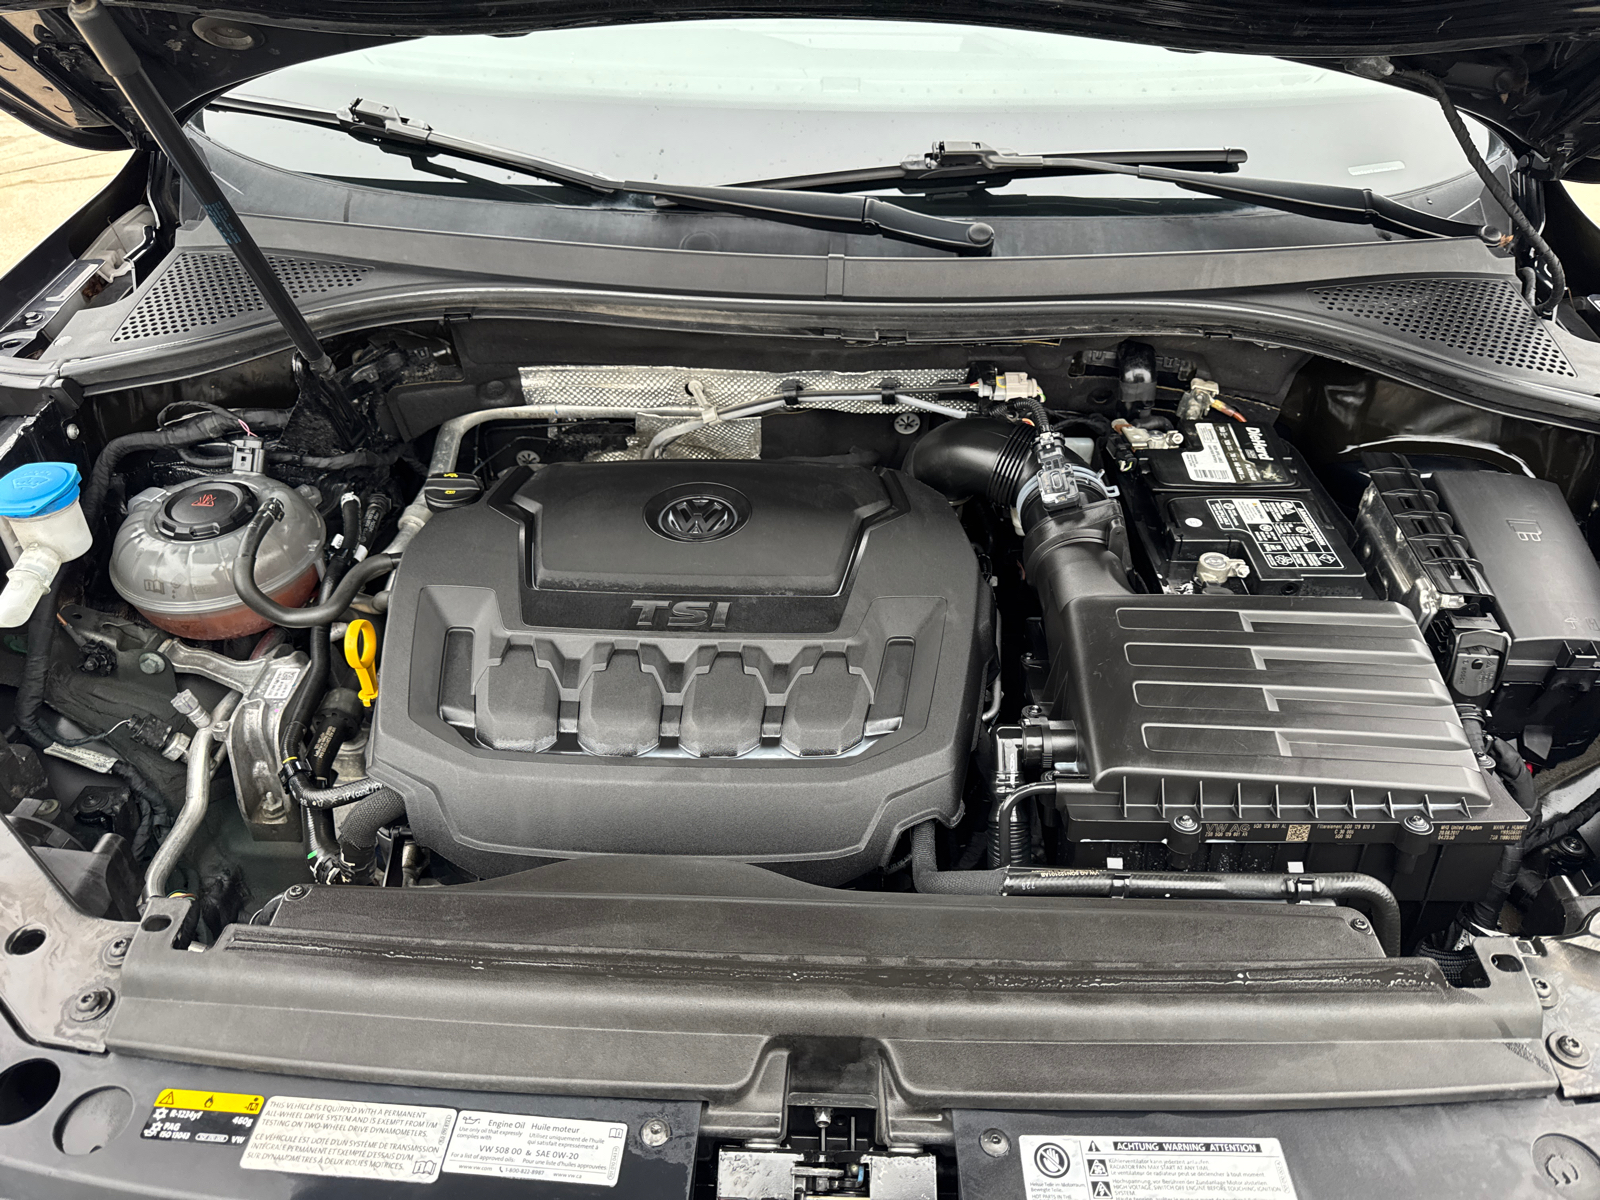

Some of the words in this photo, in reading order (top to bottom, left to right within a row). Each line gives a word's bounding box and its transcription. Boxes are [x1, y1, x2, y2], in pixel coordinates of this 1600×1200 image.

[1245, 426, 1274, 460] DieHard
[630, 600, 733, 628] TSI
[1230, 824, 1250, 832] AG
[287, 1102, 315, 1110] VEHICLE
[323, 1104, 357, 1113] EQUIPPED
[384, 1110, 427, 1118] PERMANENT
[232, 1116, 254, 1127] 460g
[265, 1110, 302, 1119] ALL-WHEEL
[326, 1114, 352, 1122] SYSTEM
[377, 1118, 404, 1126] EXEMPT
[163, 1122, 181, 1131] PAG
[262, 1119, 290, 1127] TESTING
[305, 1122, 346, 1131] TWO-WHEEL
[370, 1127, 428, 1137] DYNAMOMETERS.
[488, 1120, 513, 1128] Engine
[531, 1123, 551, 1131] Huile
[159, 1130, 171, 1138] ISO
[549, 1134, 581, 1142] uniquement
[265, 1133, 296, 1143] VÉHICULE
[311, 1137, 330, 1145] DOTÉ
[390, 1142, 440, 1153] TRANSMISSION
[1117, 1142, 1159, 1151] ACHTUNG
[1162, 1143, 1206, 1151] WARNING
[1210, 1144, 1257, 1152] ATTENTION
[287, 1145, 328, 1154] PERMANENT
[367, 1151, 395, 1160] D'ESSAIS
[552, 1151, 579, 1160] 0W-20
[345, 1158, 368, 1166] ROUES
